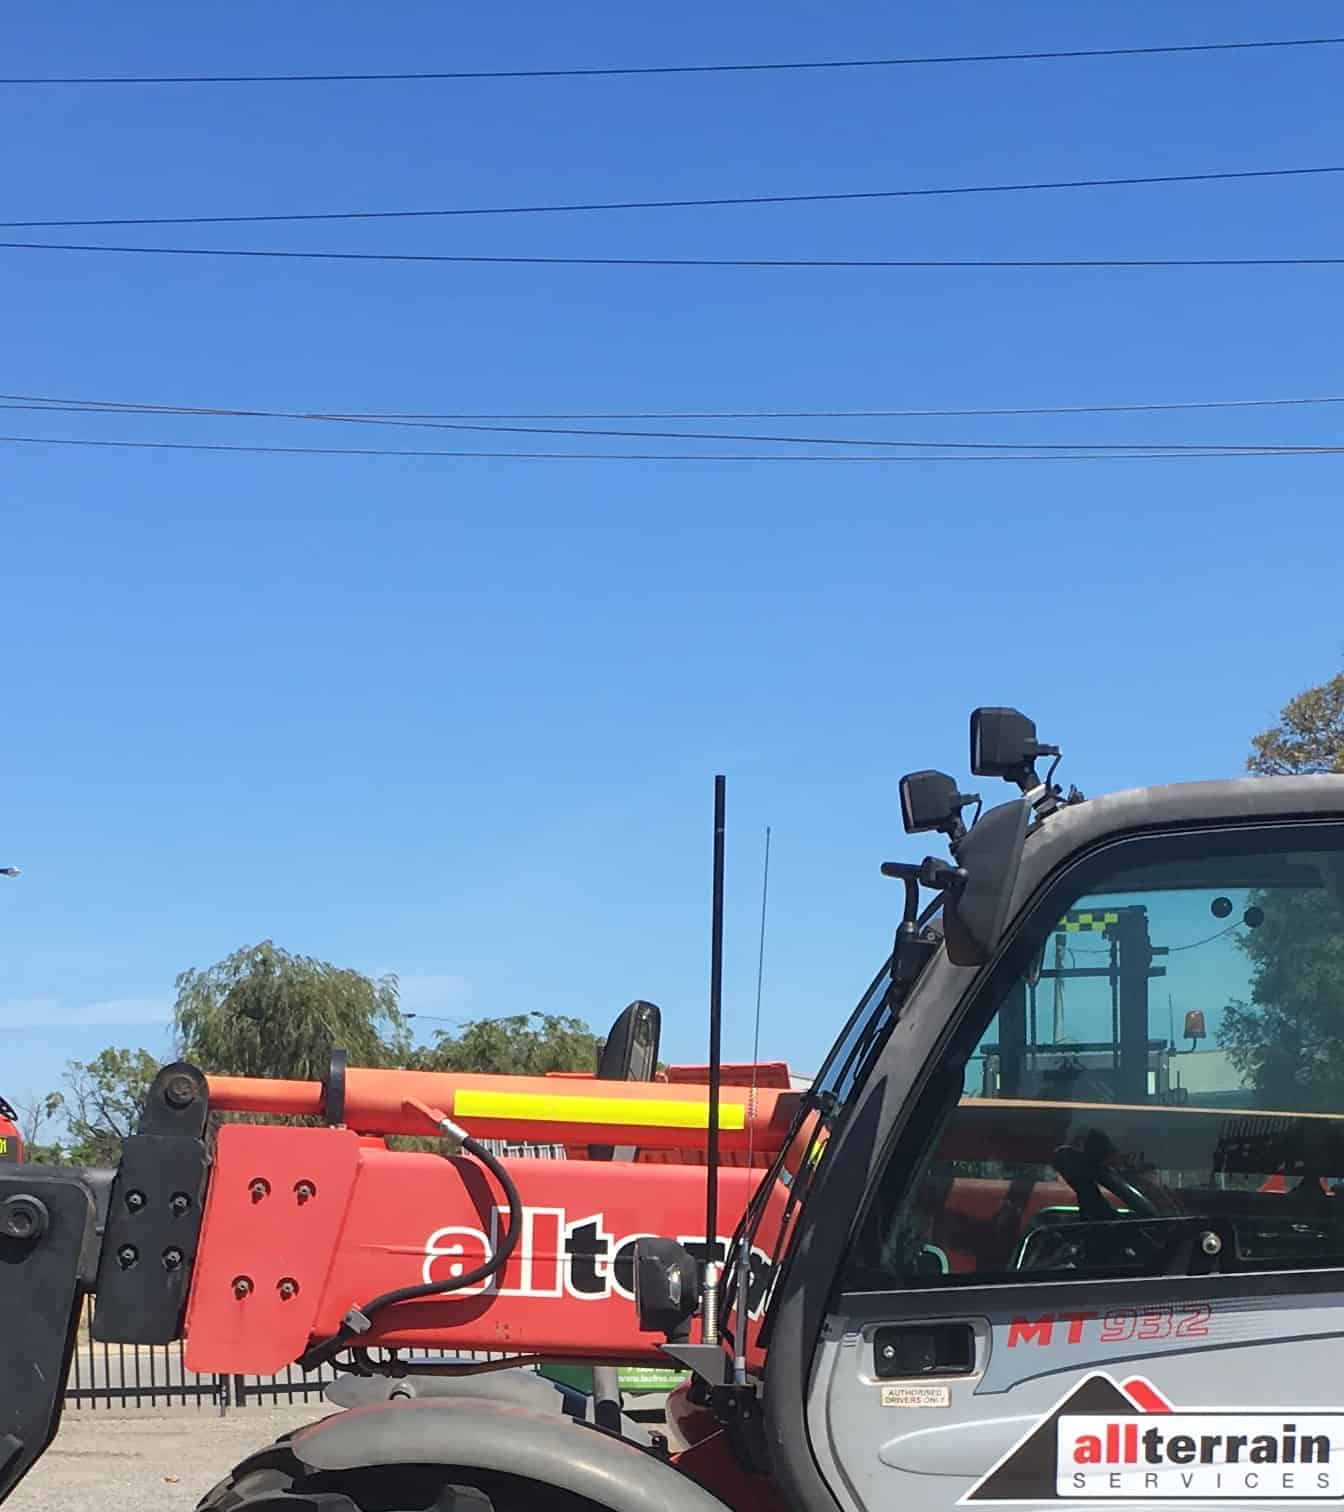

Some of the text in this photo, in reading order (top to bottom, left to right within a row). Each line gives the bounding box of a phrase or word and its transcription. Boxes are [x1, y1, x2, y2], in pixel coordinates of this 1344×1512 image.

[1007, 1303, 1213, 1348] MT 932
[1072, 1423, 1331, 1466] allterrain
[1072, 1472, 1331, 1490] SERVICES
